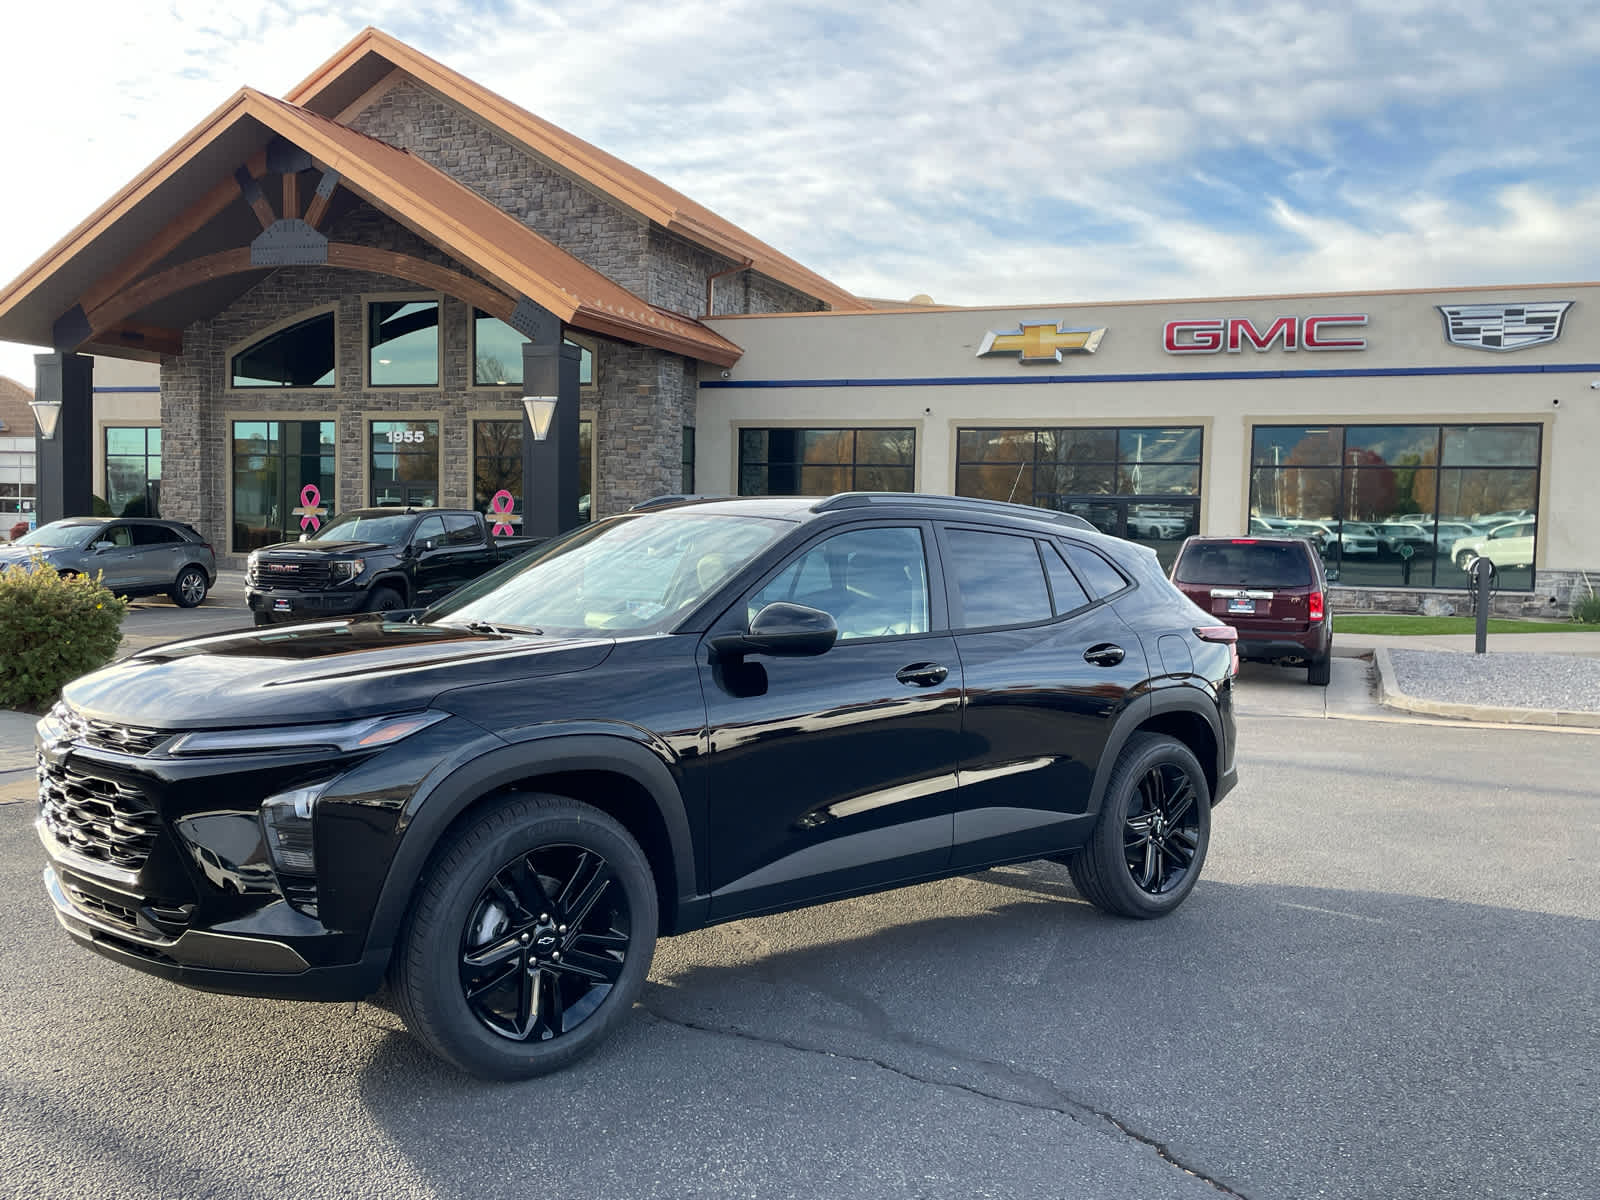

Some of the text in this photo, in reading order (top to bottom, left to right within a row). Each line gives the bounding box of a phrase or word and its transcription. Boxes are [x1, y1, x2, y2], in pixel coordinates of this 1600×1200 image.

[1163, 313, 1368, 354] GMC
[386, 430, 425, 443] 1955
[269, 564, 300, 573] GMC
